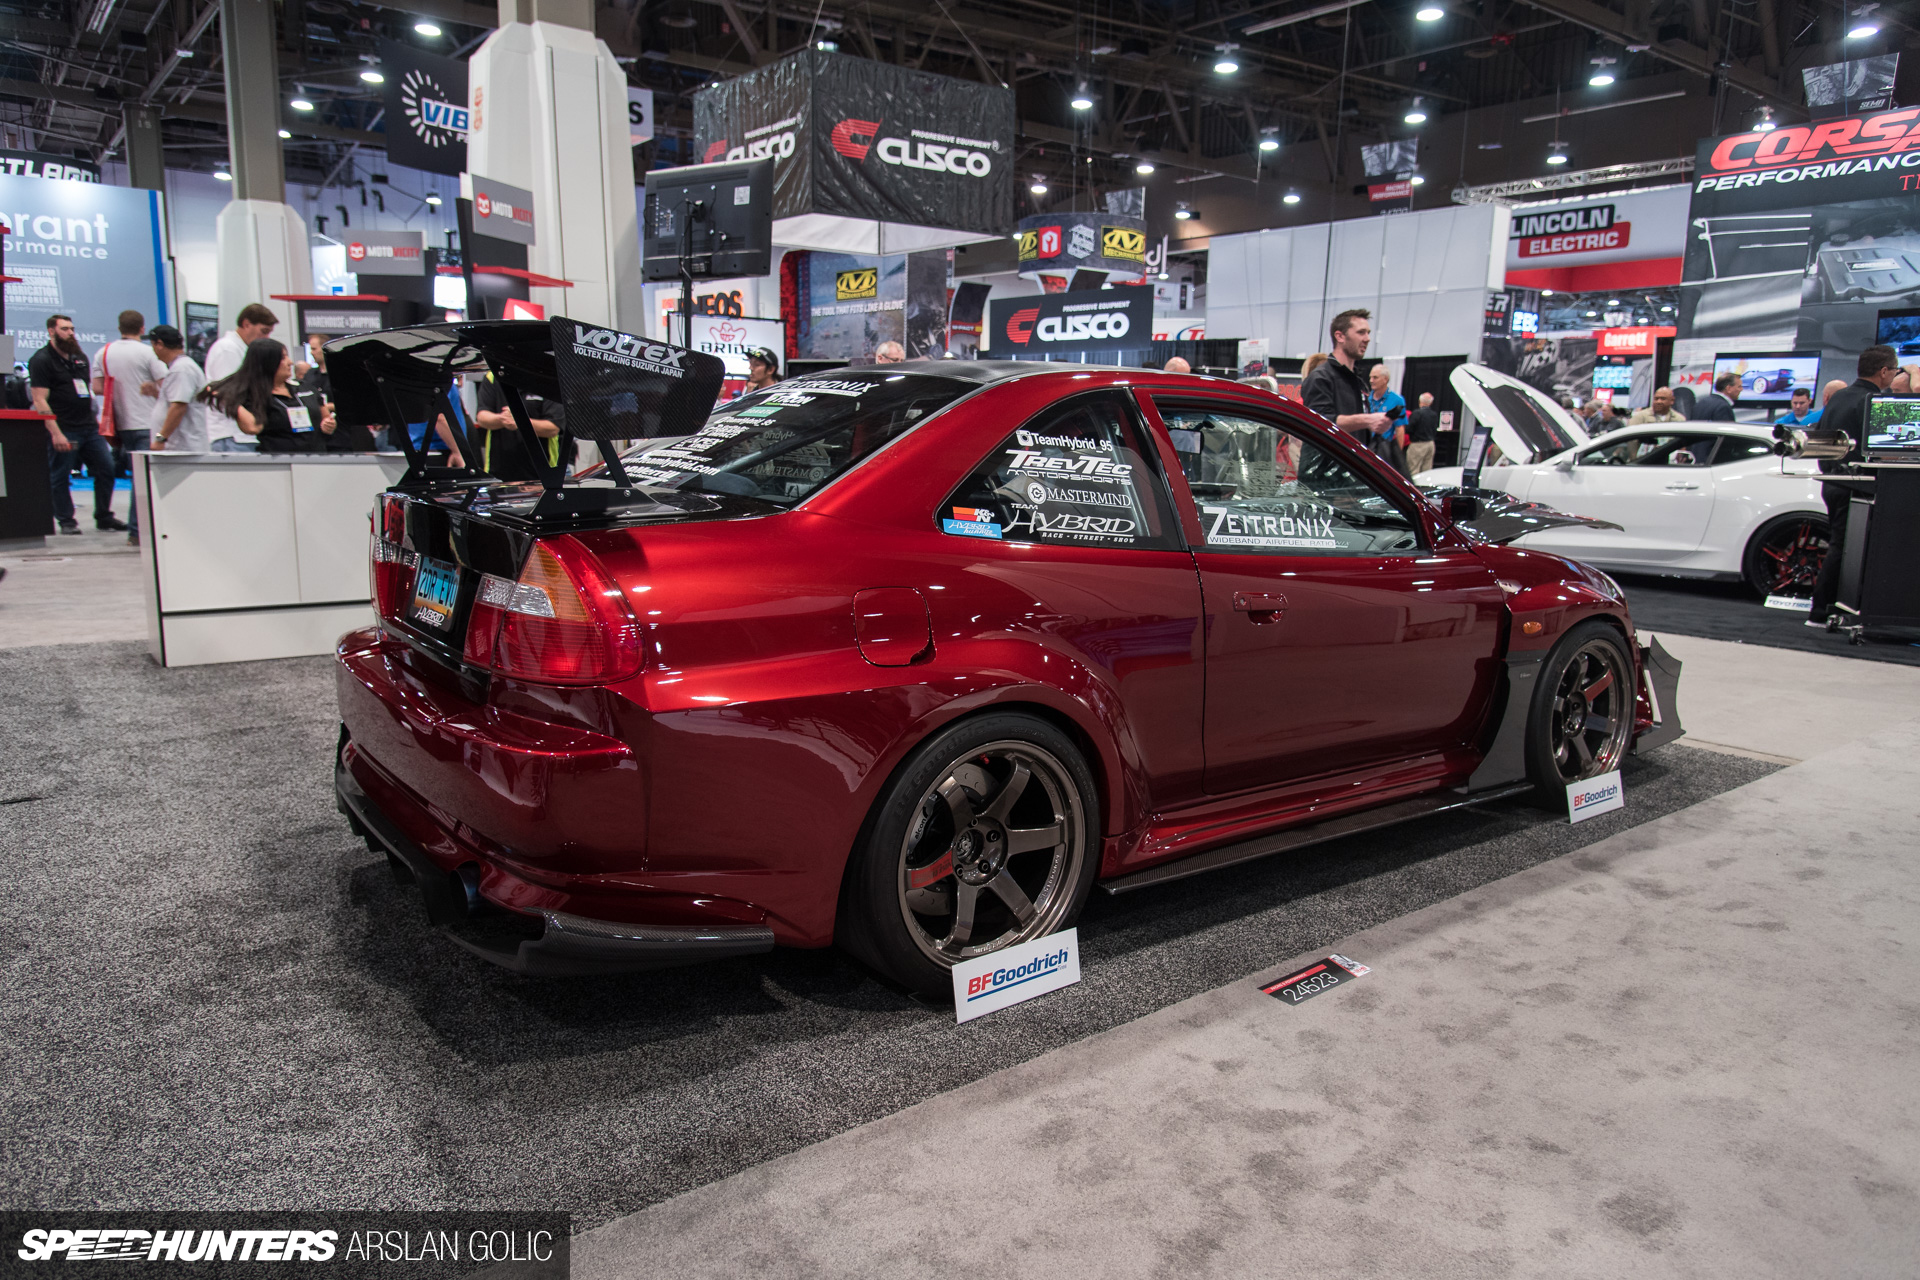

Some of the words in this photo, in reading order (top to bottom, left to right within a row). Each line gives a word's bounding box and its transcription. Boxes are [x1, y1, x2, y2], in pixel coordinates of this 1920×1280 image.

[911, 129, 956, 144] PROGRESSIVE
[955, 137, 992, 149] EQUIPMENT
[877, 136, 992, 178] CUSCO
[1695, 154, 1920, 193] PERFORMANC
[491, 201, 533, 222] MOTOVICITY
[1511, 207, 1609, 237] LINCOLN
[0, 212, 110, 245] rant
[4, 239, 109, 259] ormance
[366, 245, 420, 258] MOTOVICITY
[1529, 231, 1619, 255] ELECTRIC
[18, 330, 106, 344] PERFOANCE
[1036, 312, 1130, 341] CUSCO
[575, 325, 687, 368] VOLTEX
[1604, 332, 1648, 348] Garrett
[573, 346, 602, 360] VOLTEX
[603, 351, 631, 367] RACING
[631, 359, 660, 374] SUZUKA
[661, 367, 683, 379] JAPAN
[1032, 433, 1113, 453] TeamHybrid_95
[1006, 469, 1131, 485] MOTORSPORTS
[1010, 502, 1039, 510] TEAM
[1047, 487, 1131, 507] MASTERMIND
[1002, 510, 1136, 535] HYBRID
[1203, 506, 1335, 543] ZEITRONIX
[1209, 536, 1260, 545] WIDEBAND
[1265, 538, 1304, 546] AIR/FUEL
[1574, 785, 1617, 807] BFGoodrich
[914, 817, 927, 840] alcon
[967, 948, 1069, 996] BFGoodrich
[1283, 972, 1339, 1002] 24523
